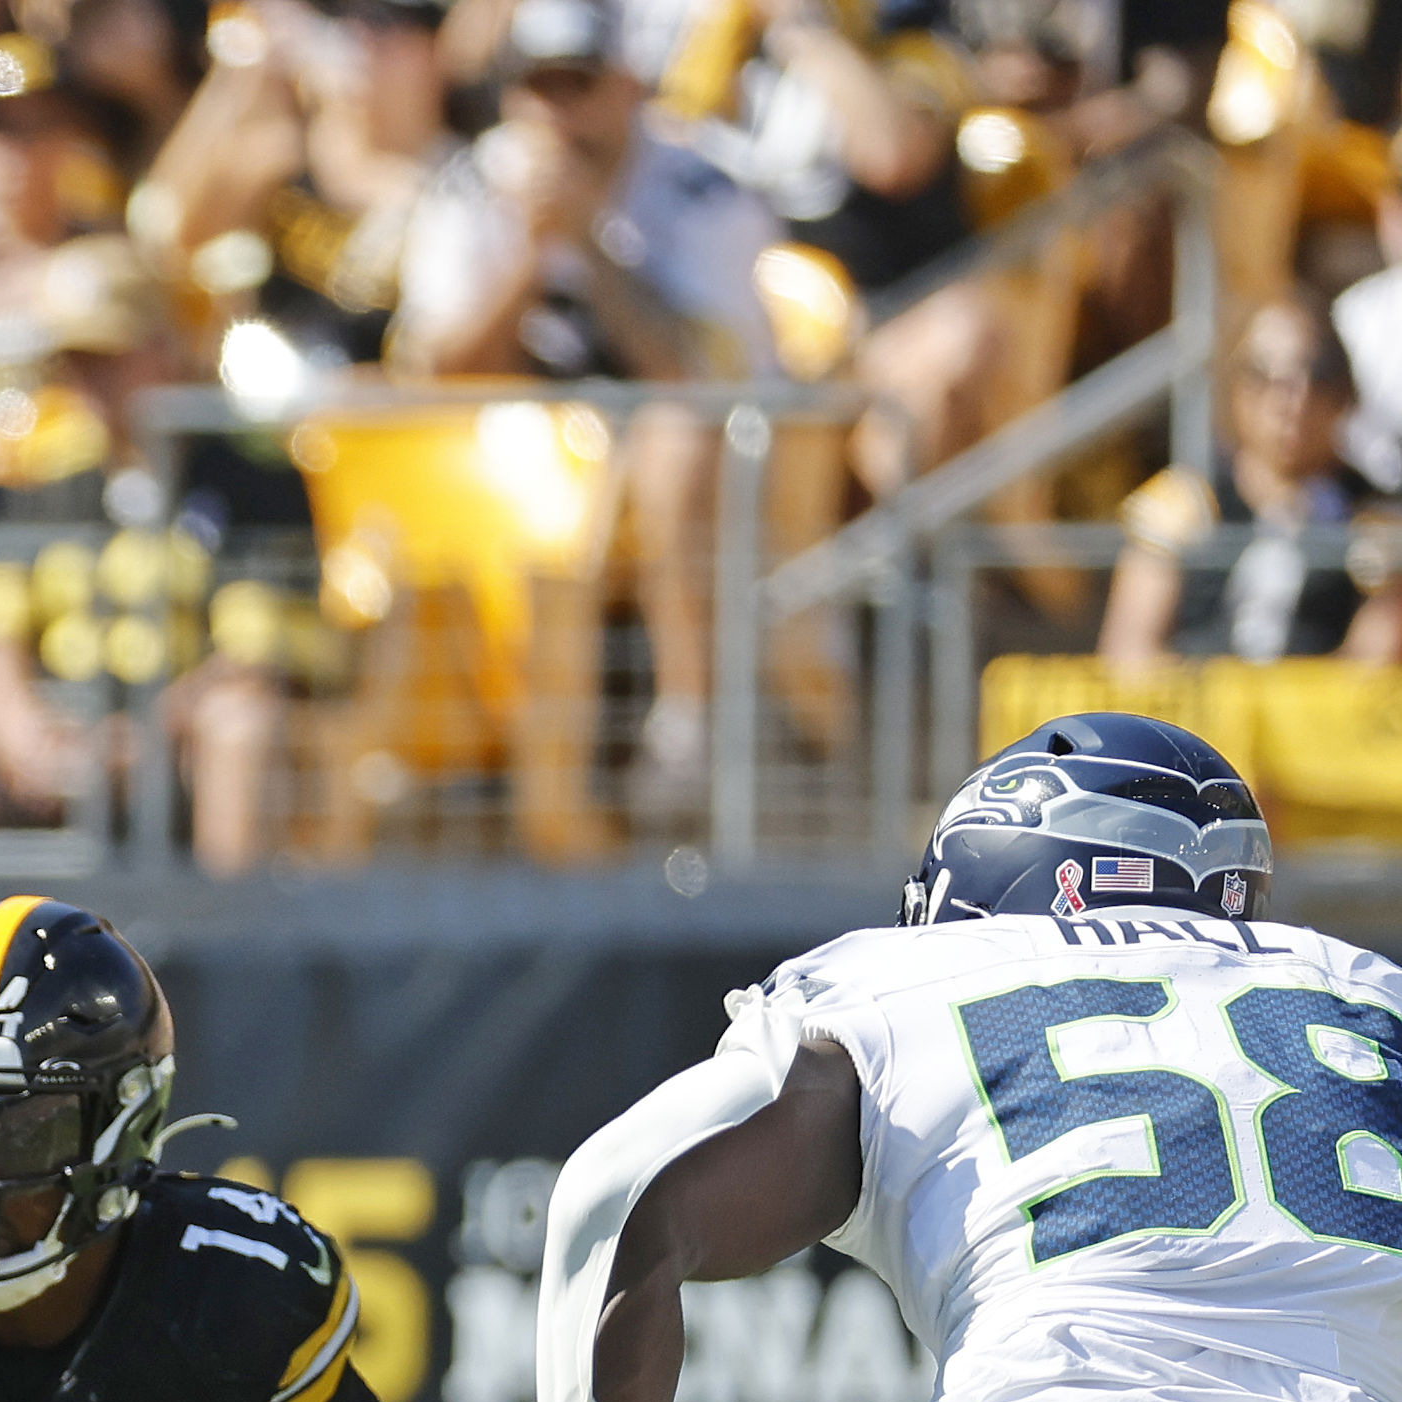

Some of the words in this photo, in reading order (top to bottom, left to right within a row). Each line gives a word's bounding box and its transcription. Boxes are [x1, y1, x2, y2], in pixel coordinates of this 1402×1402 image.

[1224, 892, 1244, 911] NFL
[1053, 917, 1294, 955] HALL
[949, 976, 1402, 1272] 58
